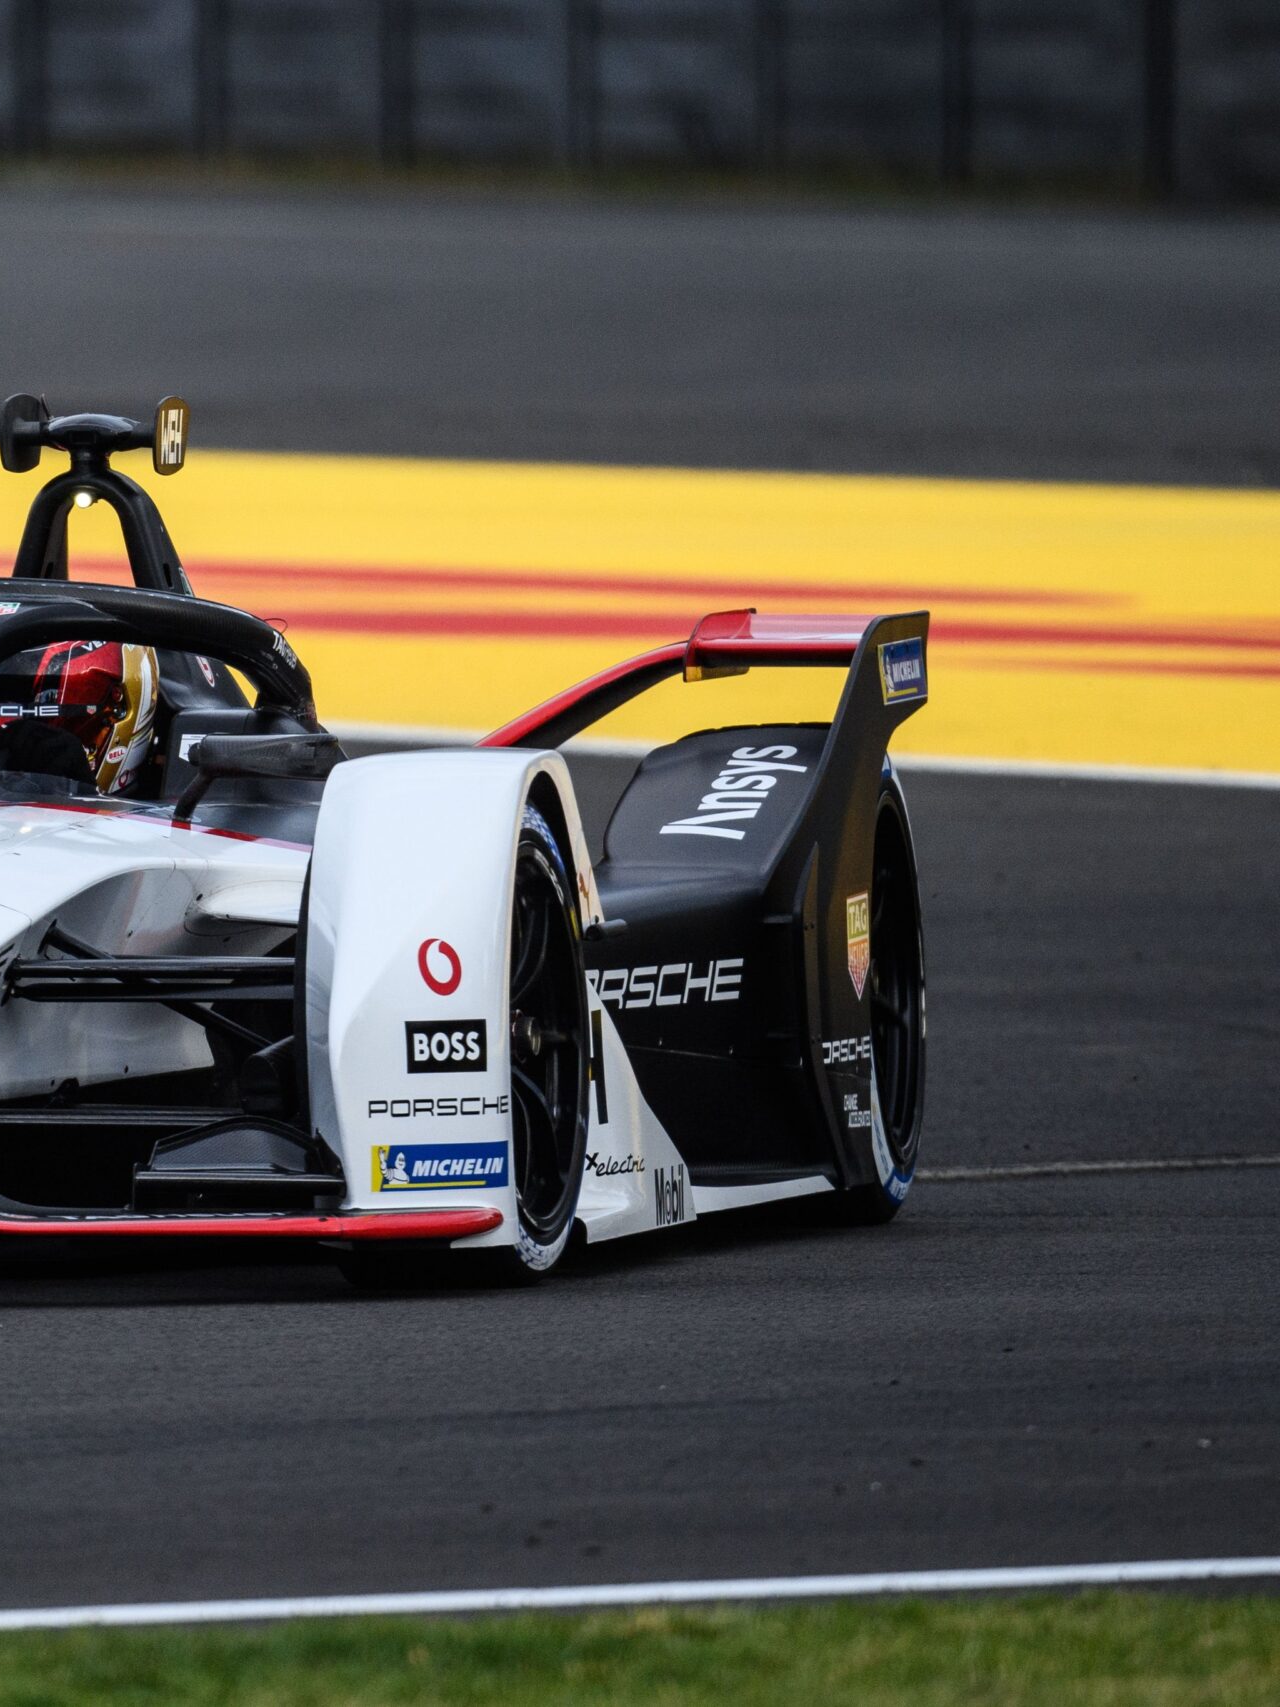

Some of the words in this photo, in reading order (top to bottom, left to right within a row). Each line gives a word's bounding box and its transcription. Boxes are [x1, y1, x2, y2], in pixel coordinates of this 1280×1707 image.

[108, 749, 125, 760] BELL
[659, 745, 808, 840] Ansys
[848, 903, 867, 935] TAG
[413, 1031, 481, 1062] BOSS
[822, 1035, 871, 1065] ORSCHE
[368, 1095, 509, 1119] PORSCHE
[412, 1156, 505, 1177] MICHELIN
[596, 1153, 646, 1177] electric
[654, 1163, 685, 1226] Mobil
